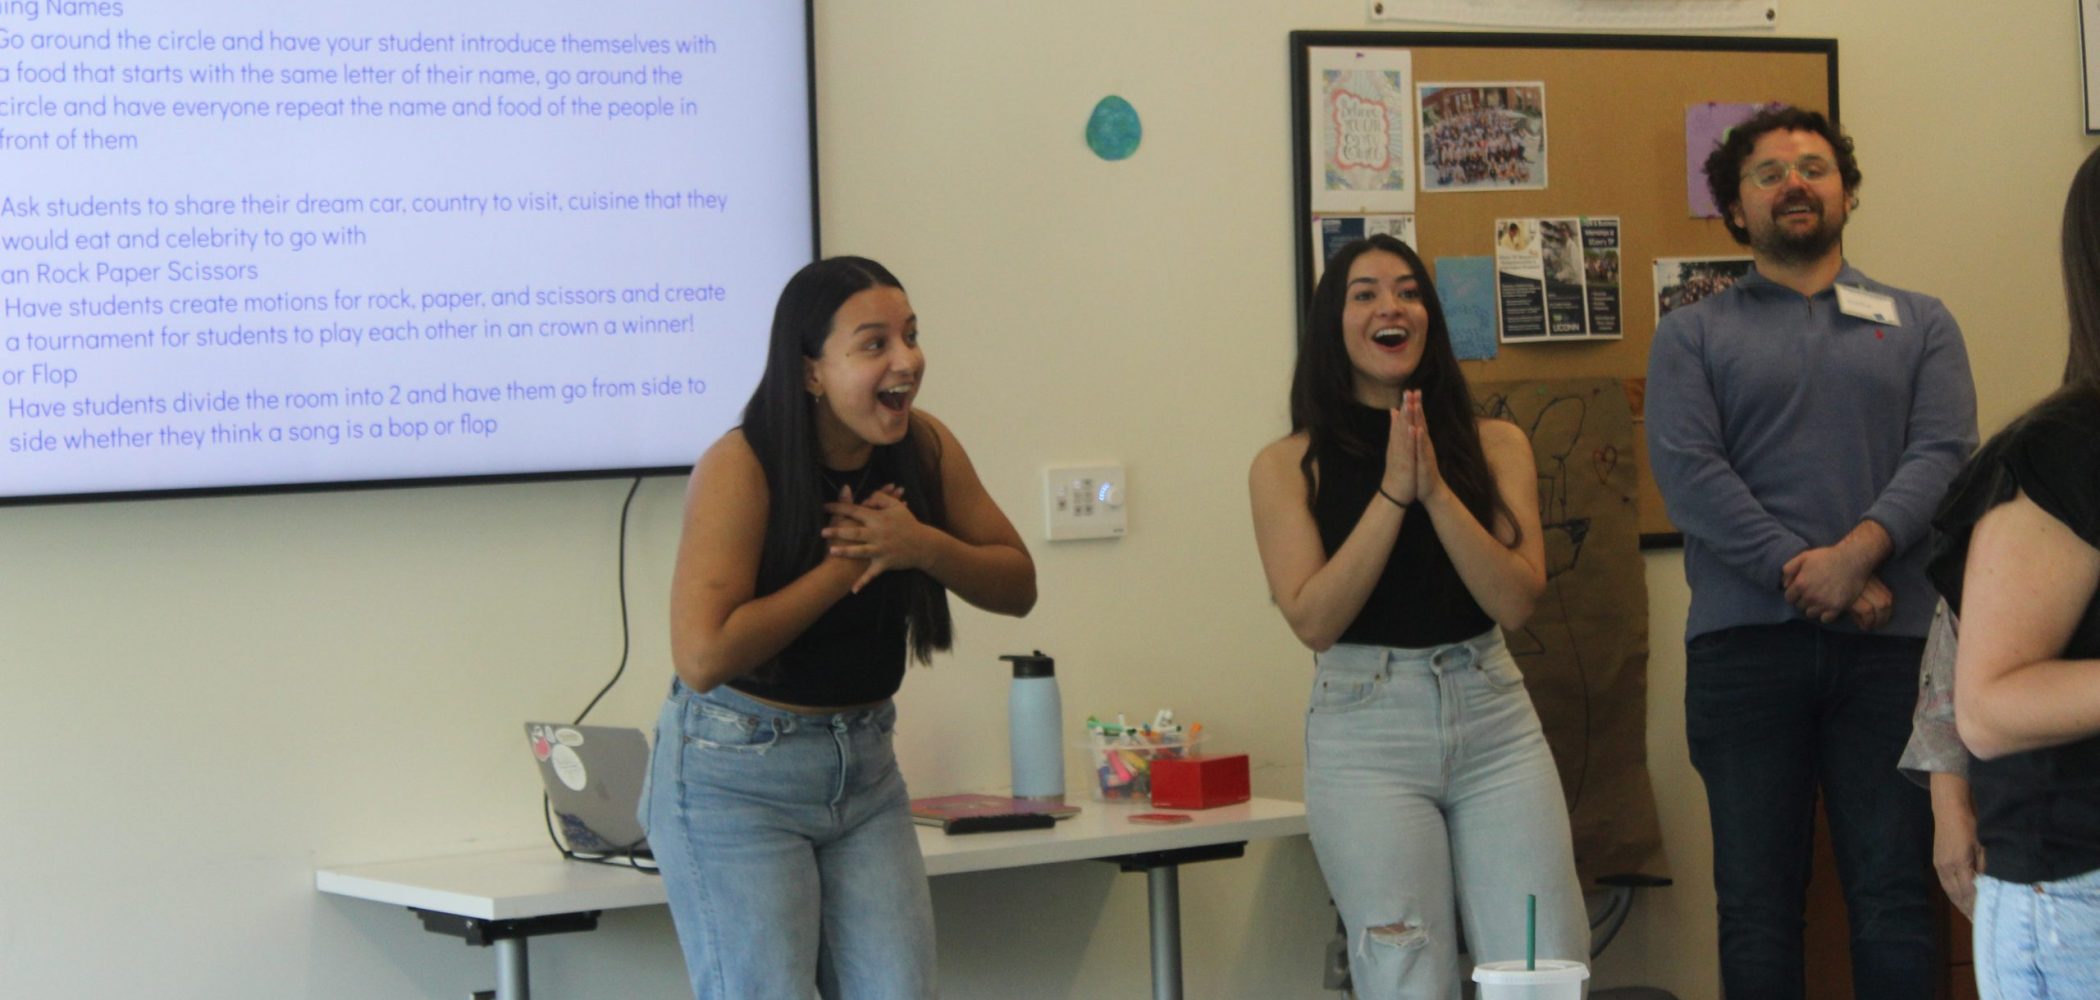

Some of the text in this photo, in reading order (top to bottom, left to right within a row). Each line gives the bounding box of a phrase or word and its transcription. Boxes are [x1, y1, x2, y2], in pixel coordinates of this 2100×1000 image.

[0, 0, 123, 21] ing Names
[31, 29, 110, 50] around
[117, 29, 151, 50] the
[158, 30, 216, 50] circle
[222, 30, 264, 51] and
[270, 30, 320, 51] have
[326, 37, 372, 56] your
[378, 32, 455, 52] student
[462, 33, 556, 53] introduce
[561, 33, 670, 54] themselves
[676, 35, 716, 53] with
[0, 61, 682, 89] a food that starts with the same letter of their name, go around the
[0, 95, 698, 120] circle and have everyone repeat the name and food of the people in
[0, 128, 138, 150] front of them
[1, 189, 727, 217] Ask students to share their dream car, country to visit, cuisine that they
[2, 225, 366, 251] would eat and celebrity to go with
[37, 262, 89, 283] Rock
[97, 262, 160, 286] Paper
[168, 261, 258, 281] Scissors
[5, 283, 725, 317] Have students create motions for rock, paper, and scissors and create
[6, 314, 693, 352] a tournament for students to play each other in an crown a winner!
[1552, 322, 1580, 332] UCONN
[2, 362, 78, 389] or Flop
[9, 376, 706, 418] Have students divide the room into 2 and have them go from side to
[10, 413, 498, 452] side whether they think a song is a bop or flop
